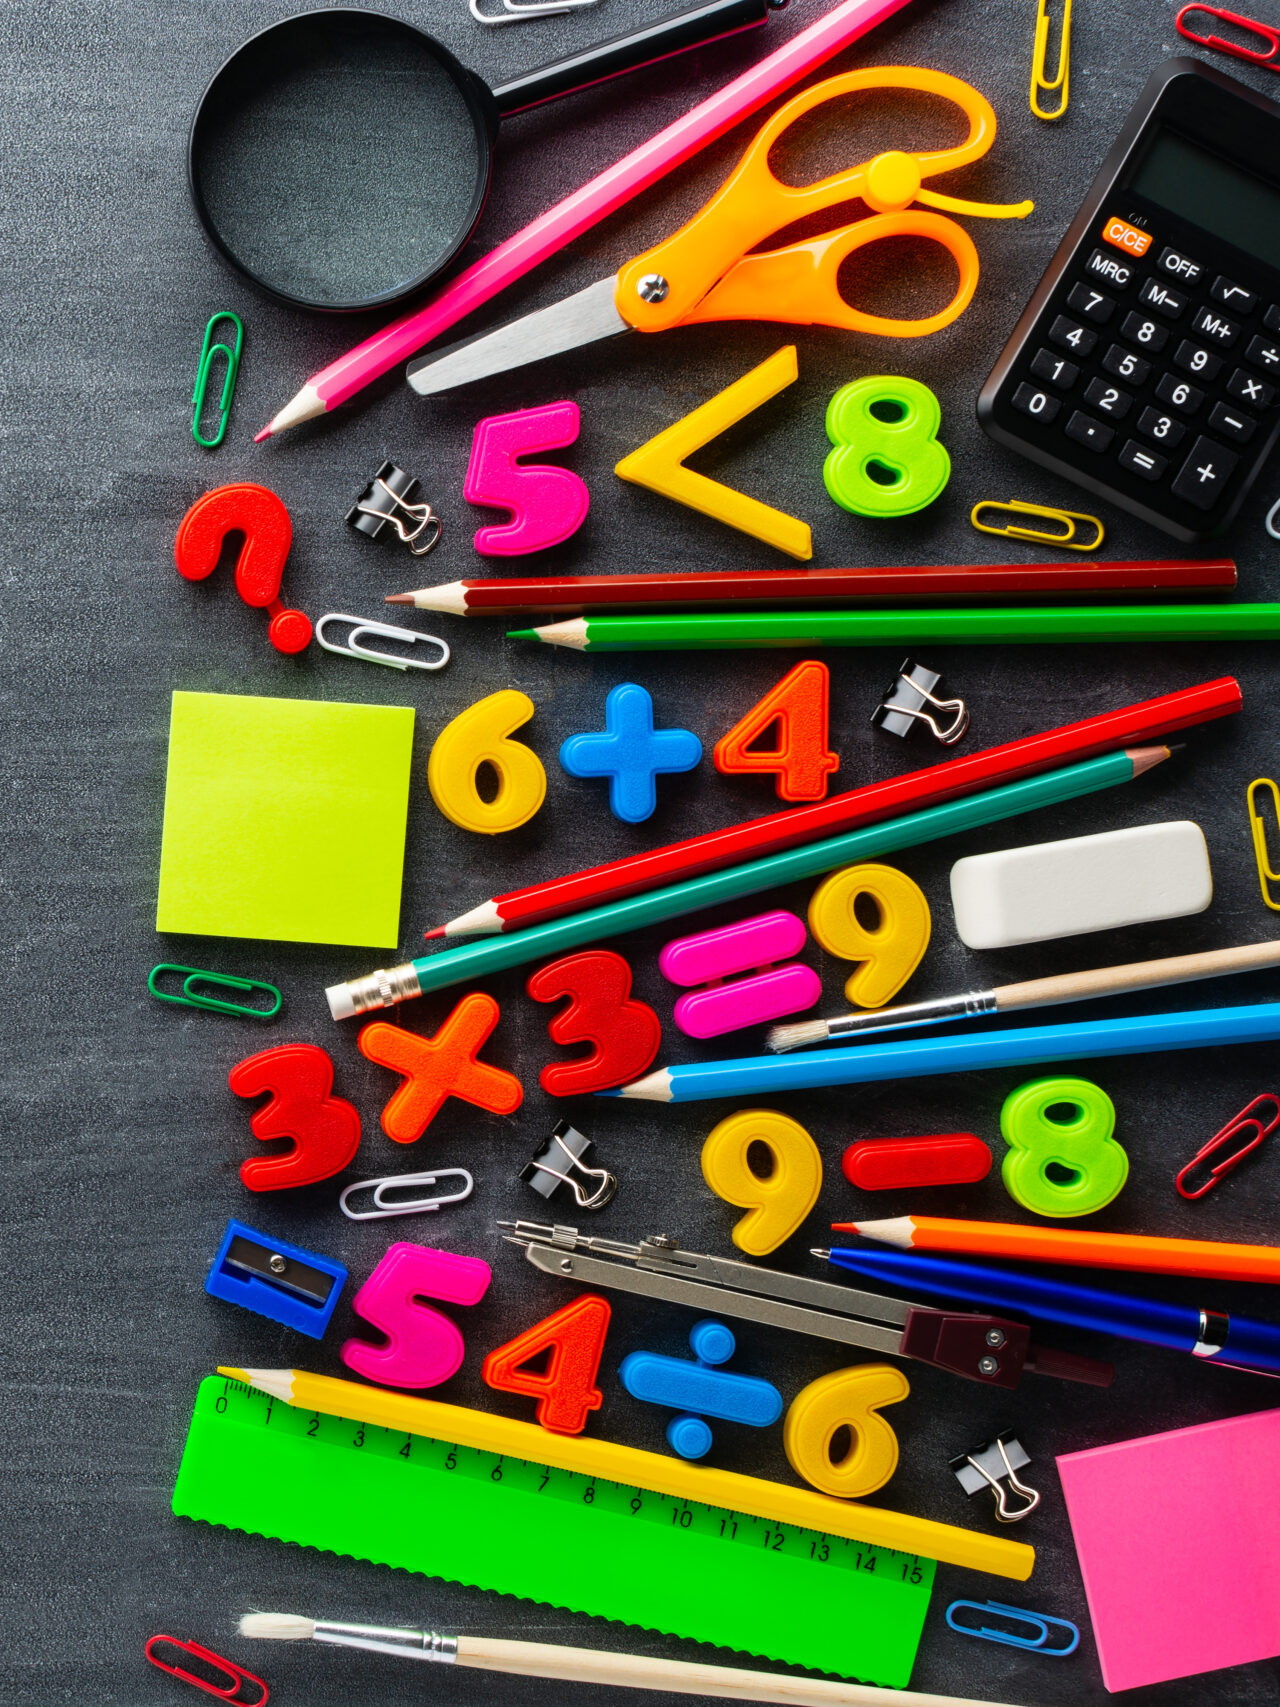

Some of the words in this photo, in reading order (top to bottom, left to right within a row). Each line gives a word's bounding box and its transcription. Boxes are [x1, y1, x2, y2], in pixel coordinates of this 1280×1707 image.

[1109, 223, 1148, 253] C/CE
[1091, 254, 1130, 284] MRC
[1165, 254, 1200, 278] OFF
[1084, 291, 1104, 311] 7
[1065, 328, 1084, 347] 4
[1137, 321, 1156, 343] 8
[1201, 314, 1232, 338] M+
[1051, 361, 1065, 380] 1
[1118, 354, 1138, 376] 5
[1190, 350, 1209, 371] 9
[1028, 392, 1047, 414] 0
[1098, 388, 1119, 411] 2
[1171, 384, 1190, 405] 6
[1153, 416, 1172, 438] 3
[461, 399, 591, 558] 5
[821, 374, 953, 518] 8
[174, 482, 313, 656] ?
[426, 688, 548, 836] 6
[712, 659, 841, 803] 4
[228, 1042, 363, 1193] 3
[525, 949, 663, 1098] 3
[807, 862, 933, 1010] 9
[699, 1108, 824, 1258] 9
[999, 1077, 1131, 1219] 8
[339, 1240, 493, 1390] 5
[480, 1293, 612, 1440] 4
[782, 1361, 912, 1500] 6
[215, 1396, 228, 1414] 0
[265, 1407, 272, 1425] 1
[307, 1418, 320, 1437] 2
[353, 1430, 366, 1448] 3
[399, 1441, 412, 1459] 4
[445, 1452, 457, 1470] 5
[491, 1464, 503, 1481] 6
[538, 1475, 550, 1492] 7
[583, 1486, 596, 1504] 8
[630, 1498, 642, 1515] 9
[671, 1507, 693, 1528] 10
[719, 1519, 739, 1540] 11
[763, 1530, 785, 1551] 12
[809, 1541, 830, 1562] 13
[855, 1552, 877, 1574] 14
[901, 1563, 923, 1584] 15
